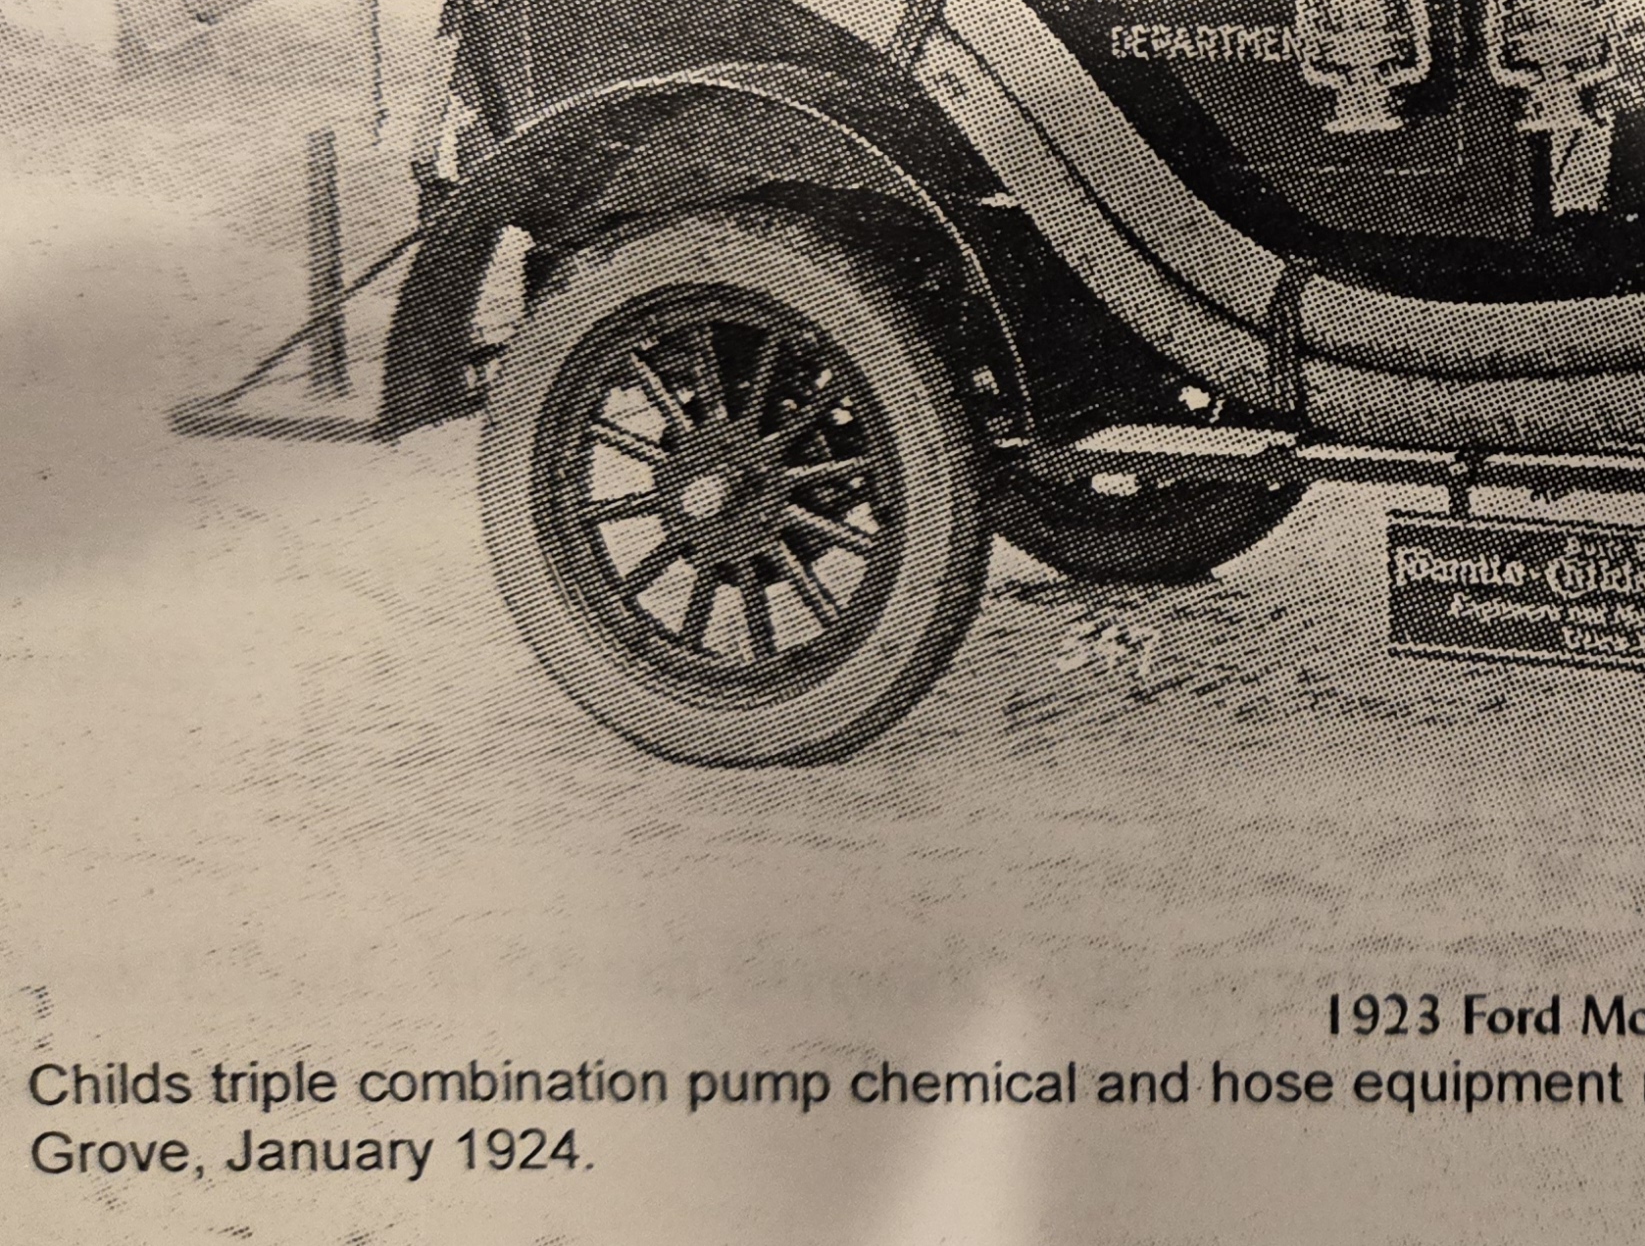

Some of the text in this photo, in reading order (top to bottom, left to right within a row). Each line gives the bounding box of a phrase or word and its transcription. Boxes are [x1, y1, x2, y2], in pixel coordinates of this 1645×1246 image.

[1110, 24, 1304, 63] DEPARTMEN
[1327, 992, 1441, 1038] 1923
[1462, 993, 1561, 1038] Ford
[27, 1061, 193, 1108] Childs
[210, 1059, 338, 1114] triple
[357, 1060, 668, 1104] combination
[688, 1070, 832, 1115] pump
[850, 1060, 1077, 1106] chemical
[1096, 1060, 1190, 1106] and
[1212, 1060, 1335, 1105] hose
[1352, 1062, 1624, 1115] equipment
[30, 1127, 595, 1183] Grove, January 1924.
